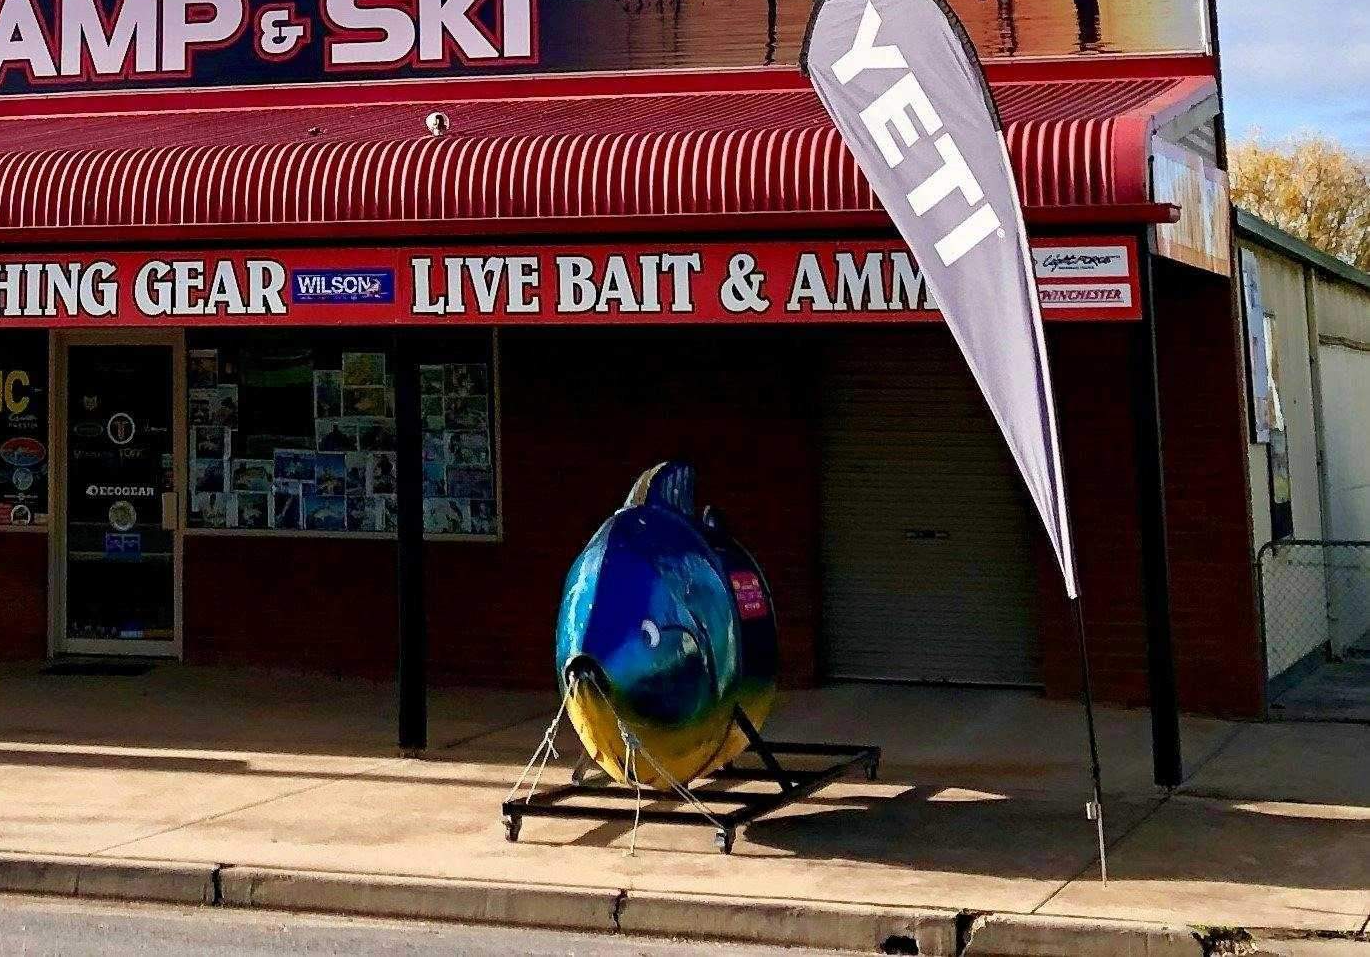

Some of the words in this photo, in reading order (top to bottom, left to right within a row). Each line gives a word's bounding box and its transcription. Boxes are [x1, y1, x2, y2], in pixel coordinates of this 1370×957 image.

[261, 5, 304, 54] &
[831, 0, 1001, 267] YETI
[134, 260, 286, 314] GEAR
[297, 276, 372, 295] WILSON
[411, 256, 539, 314] LIVE
[557, 253, 700, 312] BAIT
[720, 252, 768, 312] &
[787, 253, 940, 311] AMM
